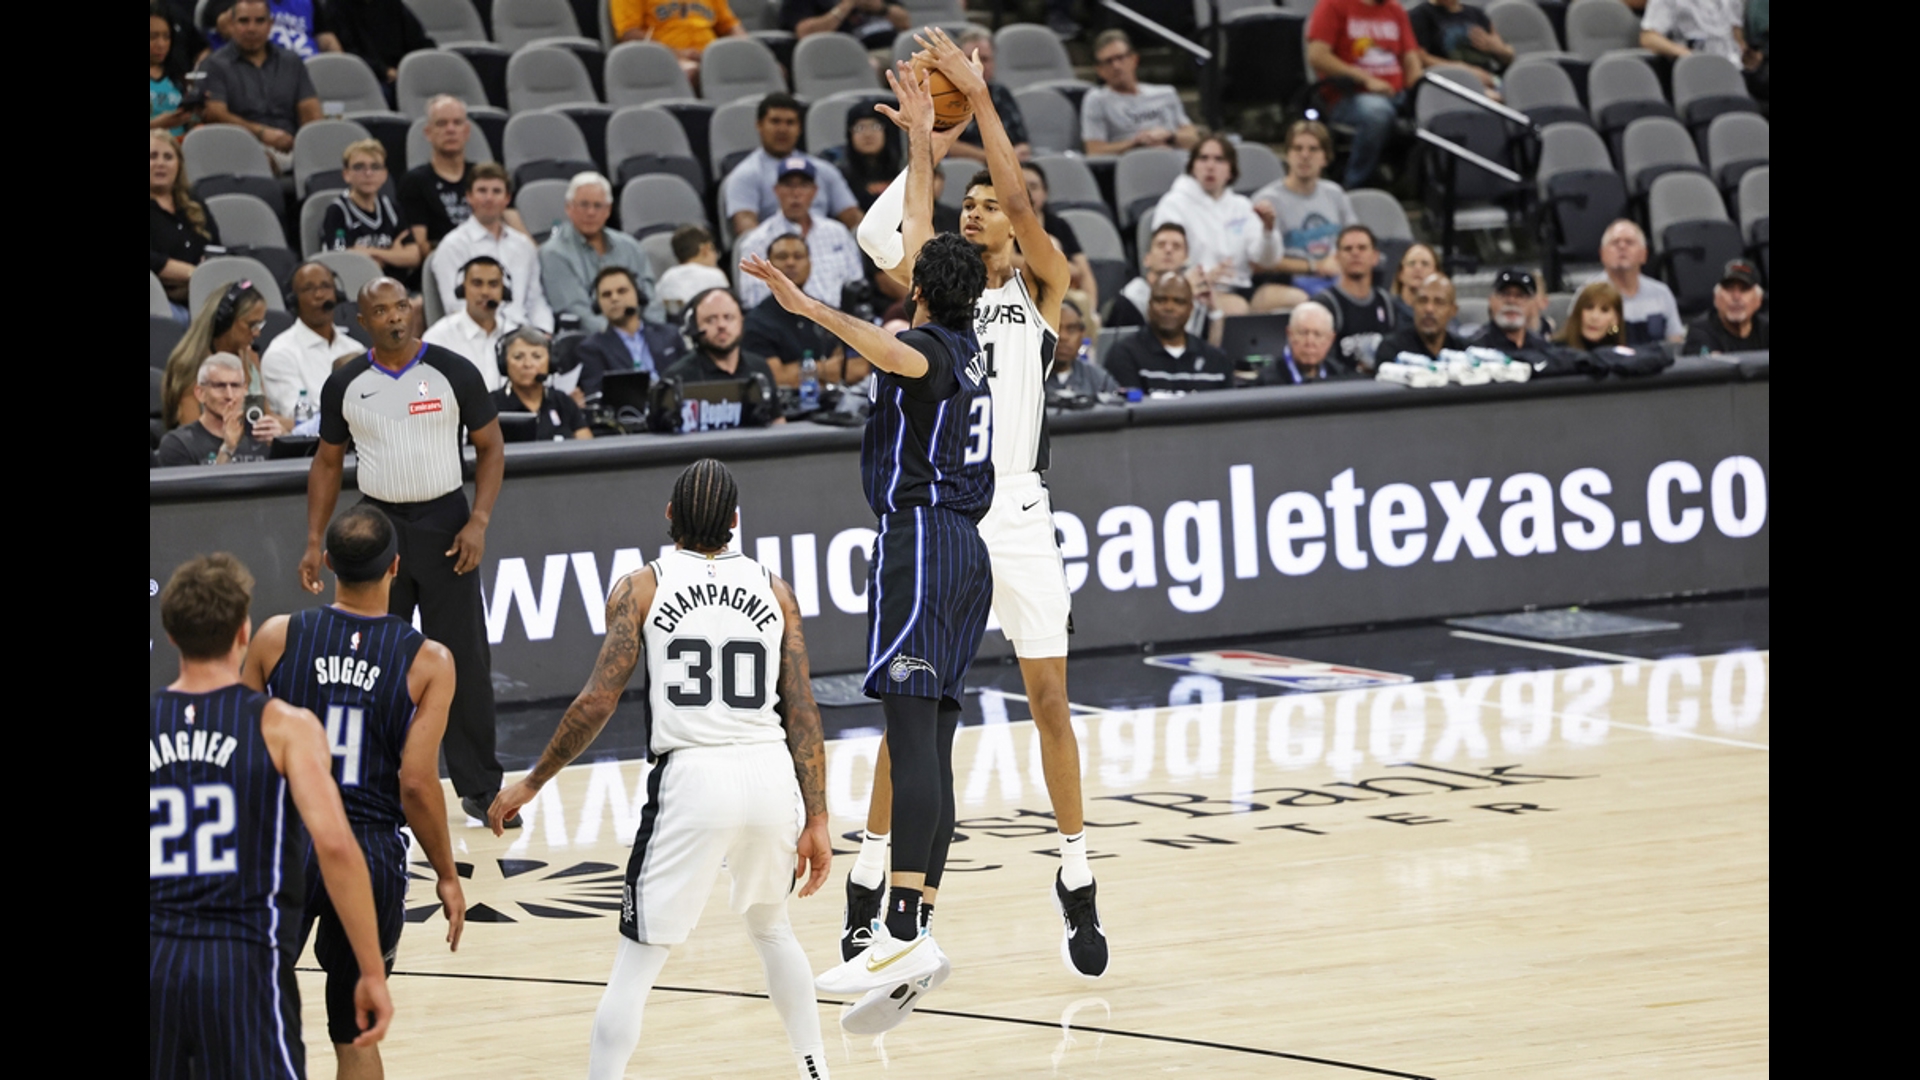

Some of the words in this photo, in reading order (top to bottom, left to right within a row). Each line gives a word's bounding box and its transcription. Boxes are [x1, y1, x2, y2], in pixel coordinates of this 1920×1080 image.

[653, 583, 778, 634] CHAMPAGNIE
[314, 655, 382, 692] SUGGS
[665, 637, 768, 710] 30
[327, 705, 365, 785] 4
[150, 783, 236, 878] 22
